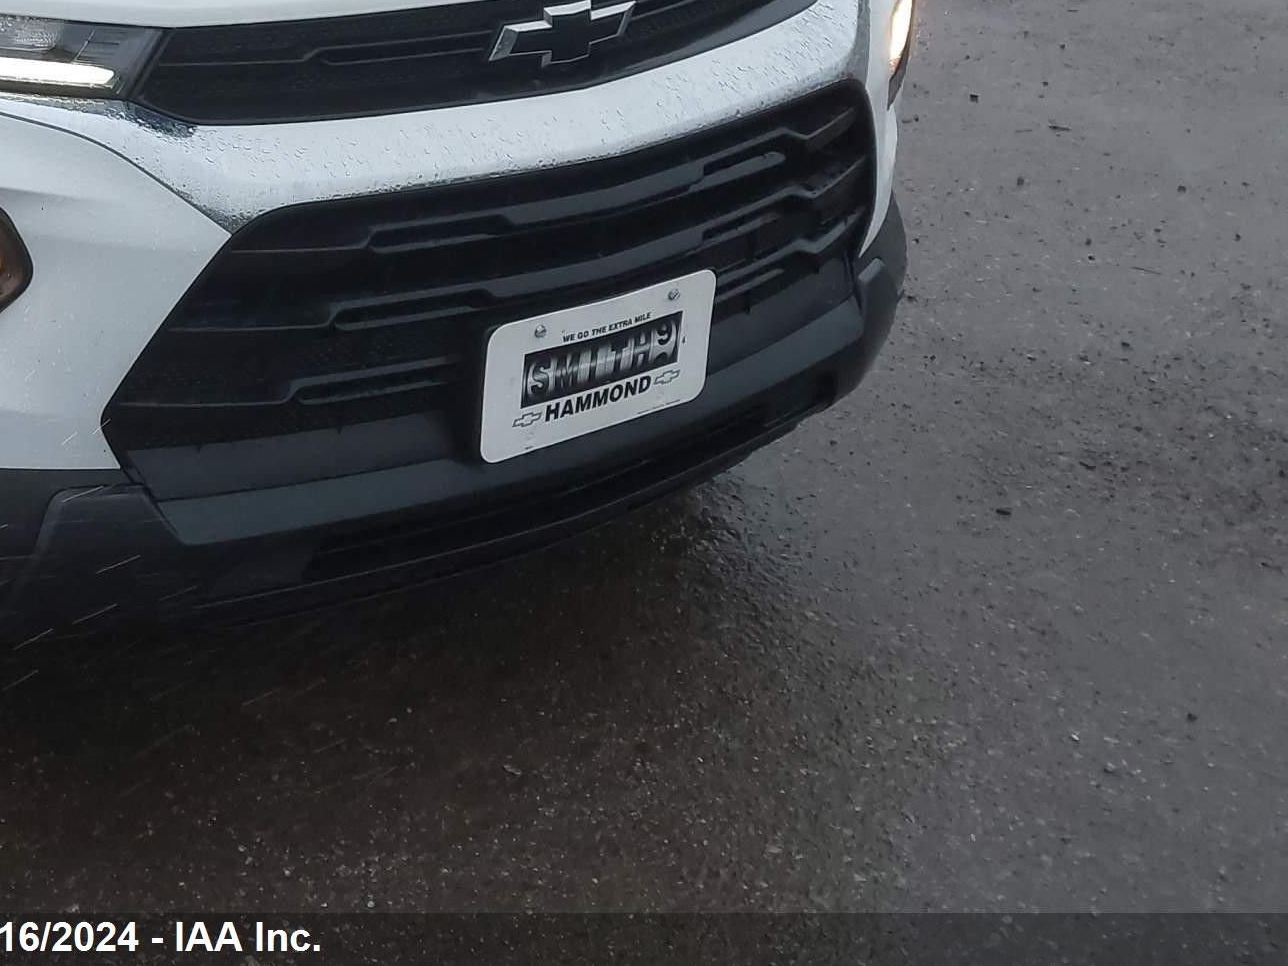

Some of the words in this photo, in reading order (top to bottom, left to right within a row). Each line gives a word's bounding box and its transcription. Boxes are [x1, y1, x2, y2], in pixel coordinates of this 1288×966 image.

[562, 333, 576, 343] WE
[577, 330, 589, 340] GO
[592, 326, 607, 336] THE
[608, 318, 633, 331] EXTRA
[634, 312, 652, 323] MILE
[545, 375, 652, 423] HAMMOND
